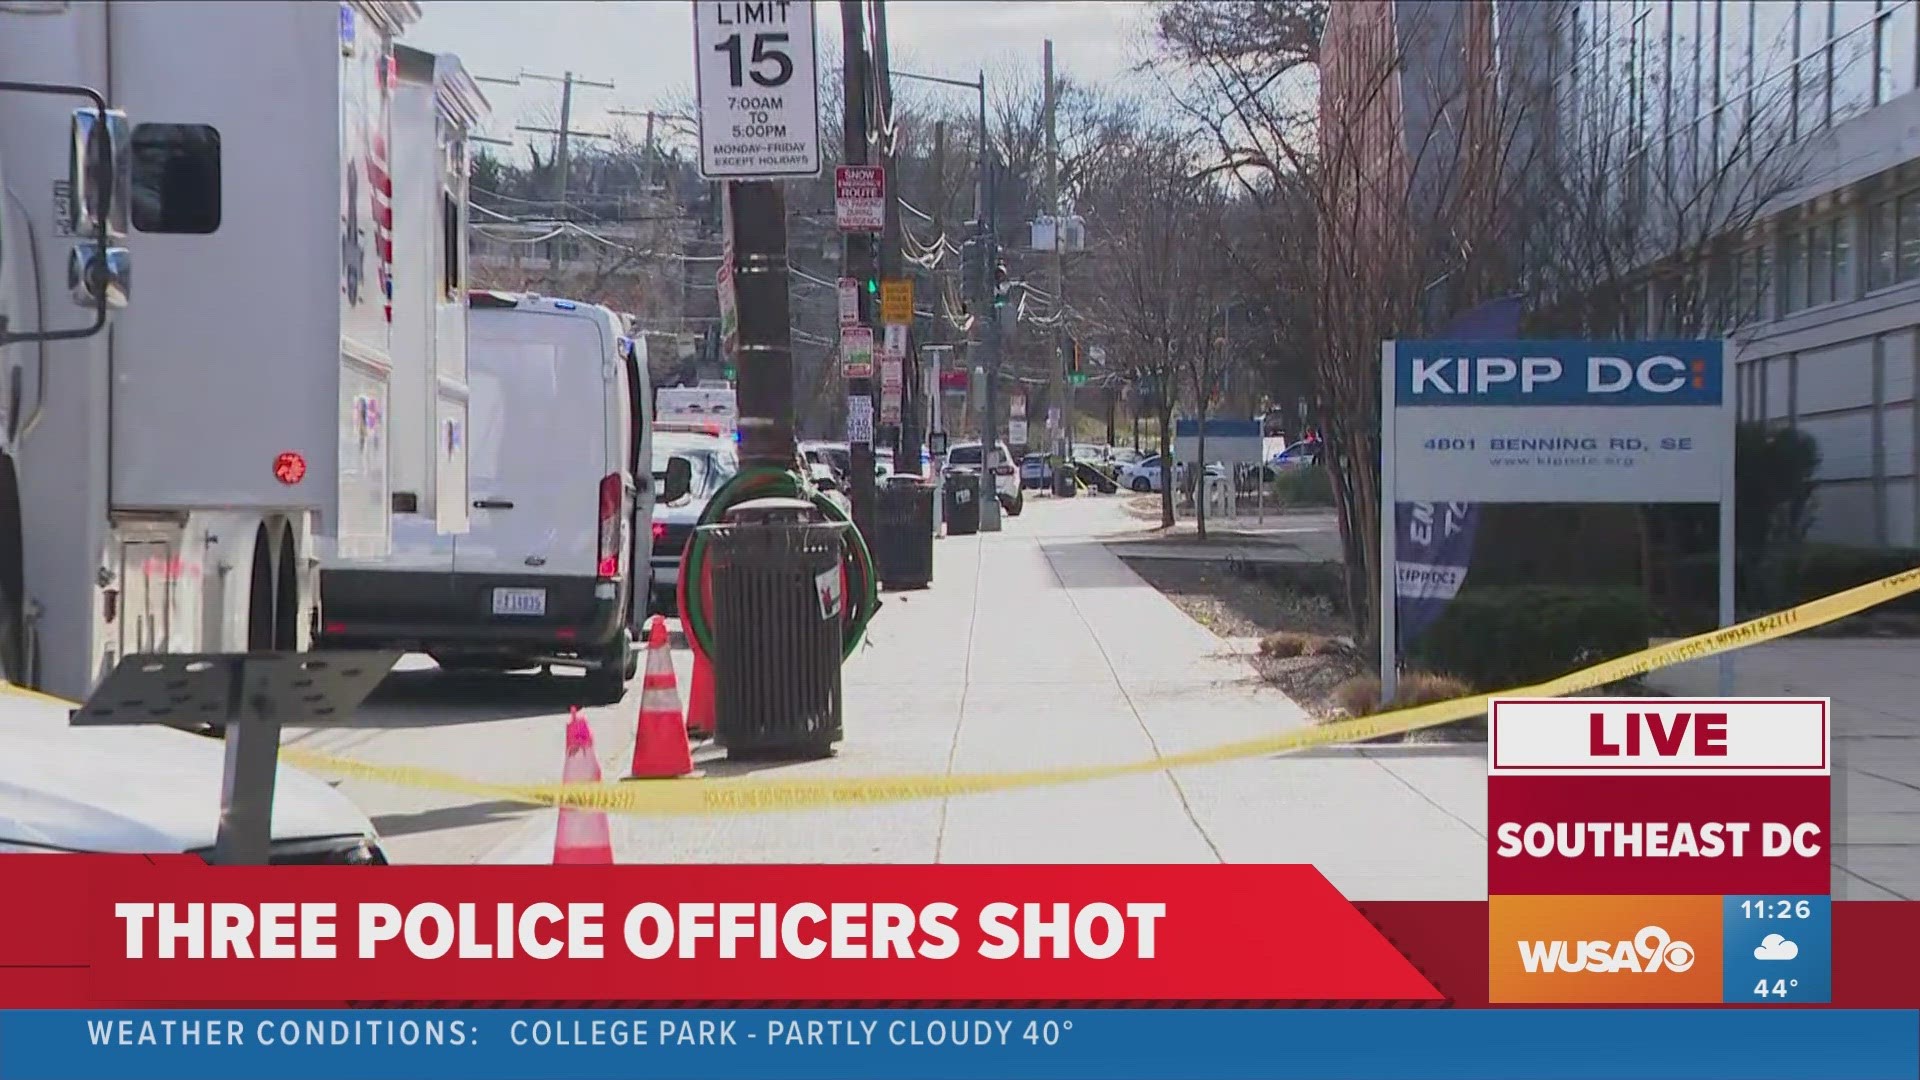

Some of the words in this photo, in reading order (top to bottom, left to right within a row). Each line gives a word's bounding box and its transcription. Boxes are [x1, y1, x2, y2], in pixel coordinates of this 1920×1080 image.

[718, 2, 790, 24] LIMIT
[715, 33, 793, 87] 15
[728, 97, 783, 110] 7:00AM
[749, 111, 768, 124] TO
[732, 125, 786, 138] 5:00PM
[715, 156, 755, 166] EXCEPT
[759, 154, 808, 165] HOLIDAYS
[844, 169, 875, 180] SNOW
[841, 188, 878, 198] ROUTE
[1411, 357, 1563, 394] KIPP
[1587, 356, 1706, 393] DC:
[1423, 437, 1475, 451] 4801
[1490, 437, 1597, 451] BENNING
[1609, 437, 1649, 452] RD,
[1659, 437, 1693, 450] SE
